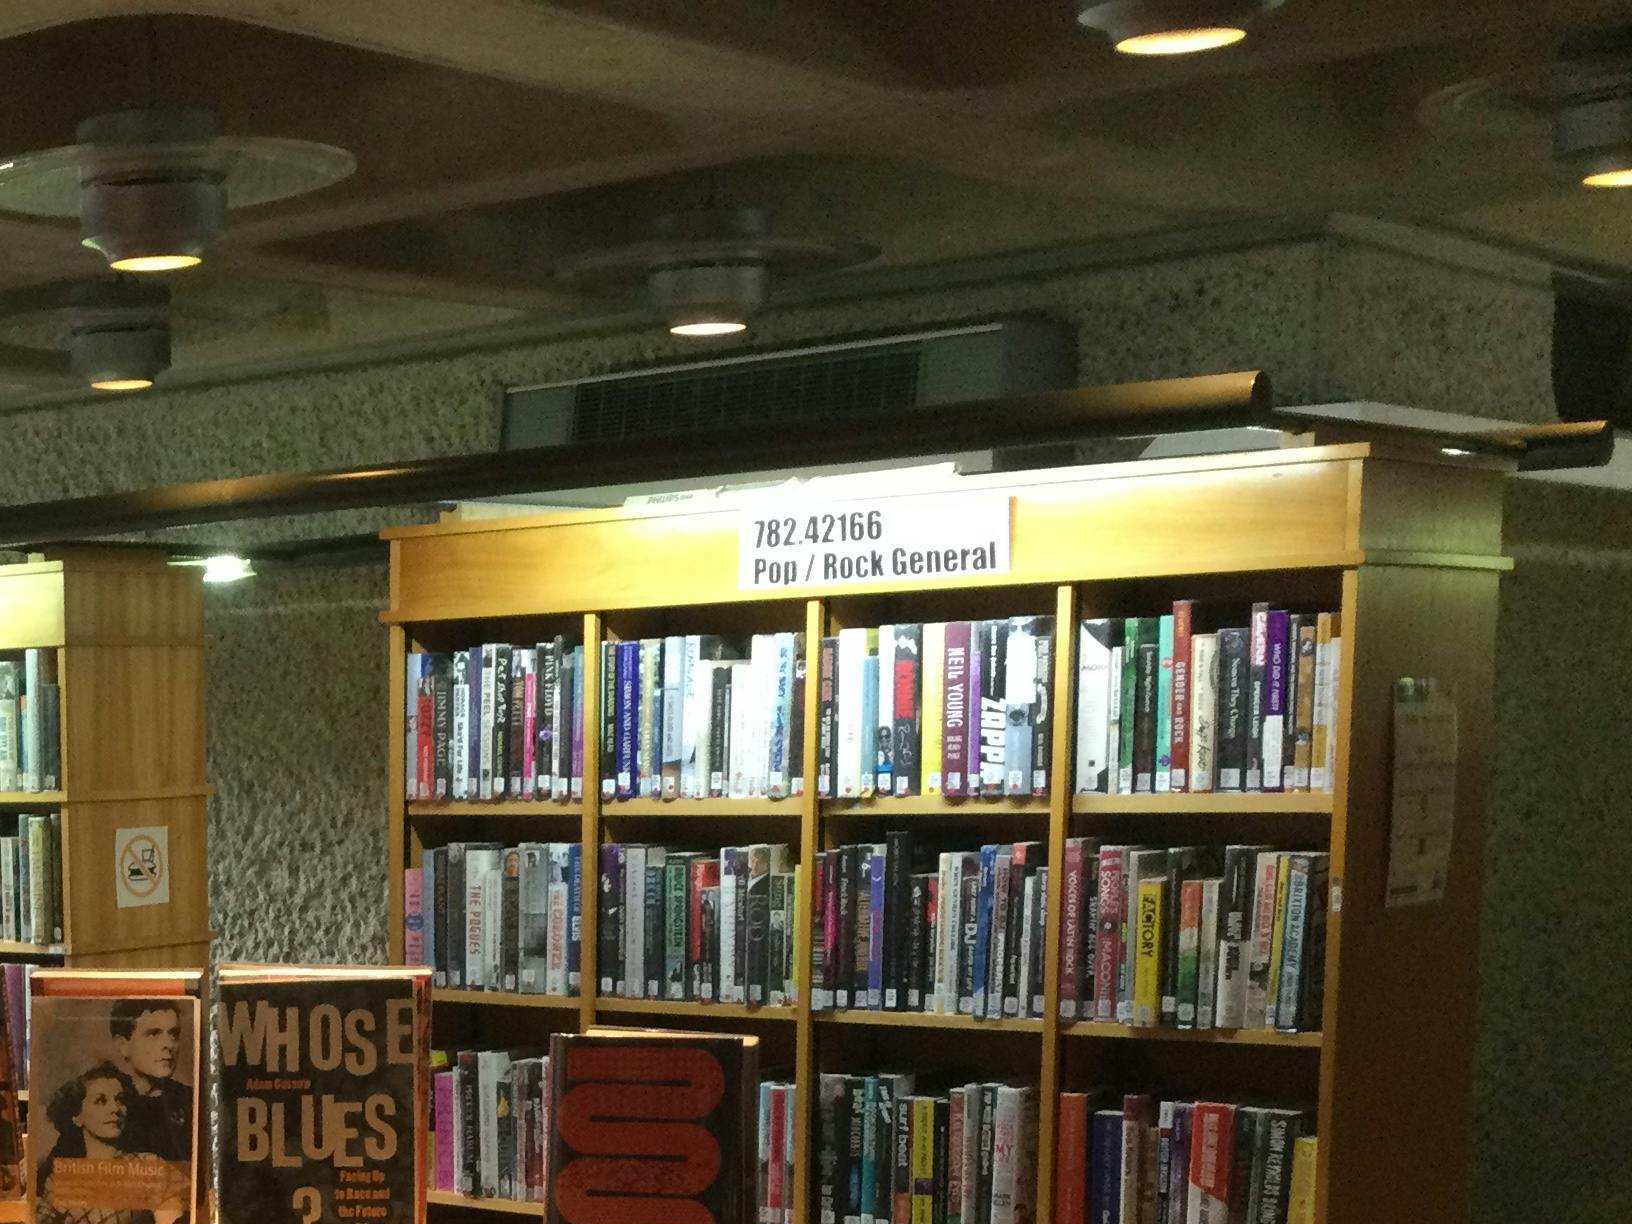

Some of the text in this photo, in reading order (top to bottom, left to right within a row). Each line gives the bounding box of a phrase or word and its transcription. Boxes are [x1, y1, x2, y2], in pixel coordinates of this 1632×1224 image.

[754, 510, 883, 549] 782.42166
[753, 558, 798, 586] Pop
[823, 550, 884, 581] Rock
[892, 541, 997, 576] General
[1254, 611, 1267, 667] CAVERN
[497, 658, 507, 680] Pet
[544, 655, 555, 717] PINK FLOYD
[947, 648, 965, 728] NEIL YOUNG
[436, 690, 447, 767] JIMMY PAGE
[1174, 661, 1186, 744] GENDER ROCK
[980, 696, 1006, 785] ZAPPA
[673, 866, 684, 948] BRUCE SPRINGSTEEN
[1067, 869, 1078, 903] VOICES
[1100, 869, 1112, 915] SONGS
[468, 886, 482, 956] THE POGUES
[748, 893, 768, 943] ROD
[964, 923, 978, 945] DJ
[1066, 918, 1076, 947] LATIN
[1142, 894, 1157, 958] FACTORY
[1286, 880, 1304, 969] BRIXTON ACADEMY
[1064, 949, 1075, 976] ROCK
[218, 997, 417, 1077] WHOSE
[237, 1093, 399, 1169] BLUES
[898, 1102, 909, 1167] surf beat
[54, 1159, 165, 1177] British Film Music
[339, 1170, 386, 1185] Facing Up
[347, 1188, 369, 1201] Race
[371, 1189, 391, 1201] and
[337, 1205, 388, 1219] the Future
